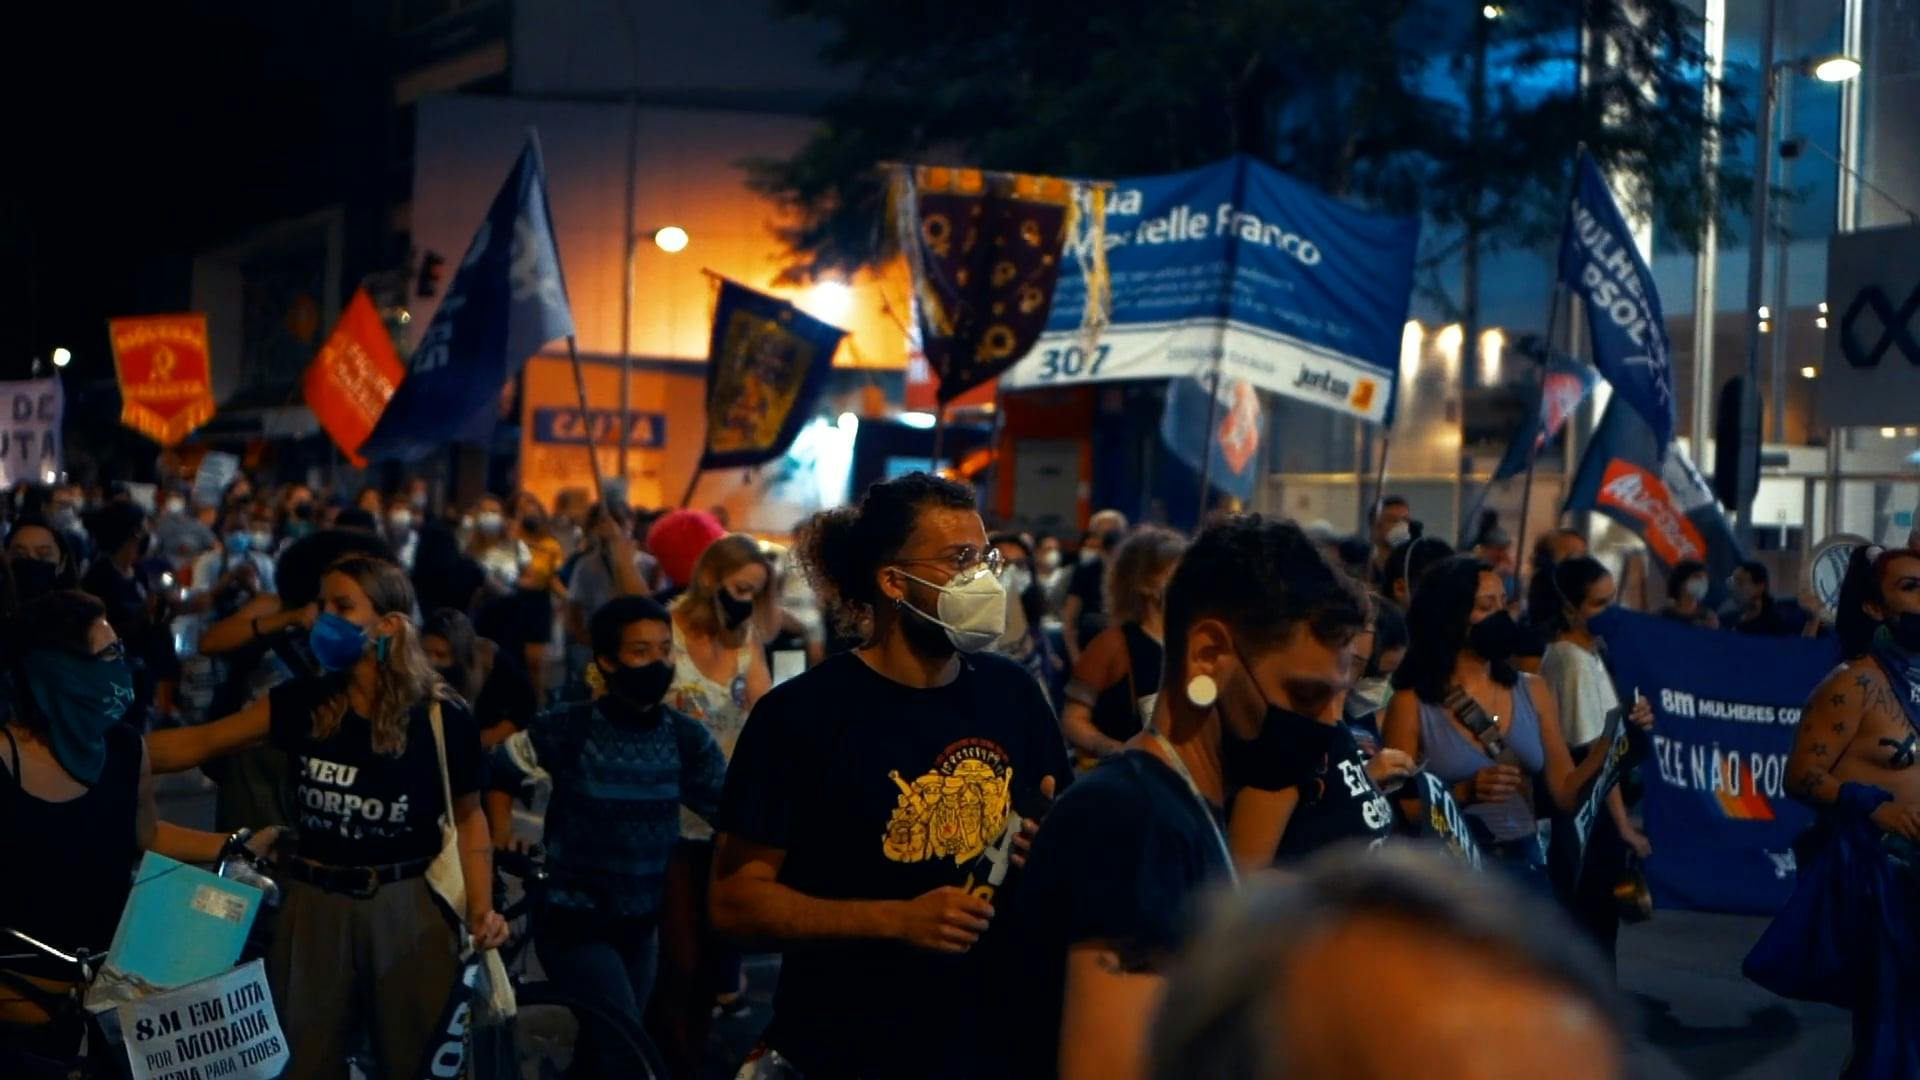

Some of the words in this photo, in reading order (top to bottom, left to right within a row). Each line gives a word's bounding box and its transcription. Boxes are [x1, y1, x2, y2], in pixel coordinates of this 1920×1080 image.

[1039, 343, 1111, 380] 307
[1698, 699, 1775, 724] MULHERES
[1690, 740, 1740, 797] NÃO
[388, 793, 410, 824] É
[135, 1010, 182, 1041] 8M
[188, 998, 226, 1027] EM
[227, 980, 265, 1015] LUTA
[146, 1050, 174, 1071] POR
[176, 1009, 269, 1062] MORADIA
[238, 1036, 282, 1068] TODES
